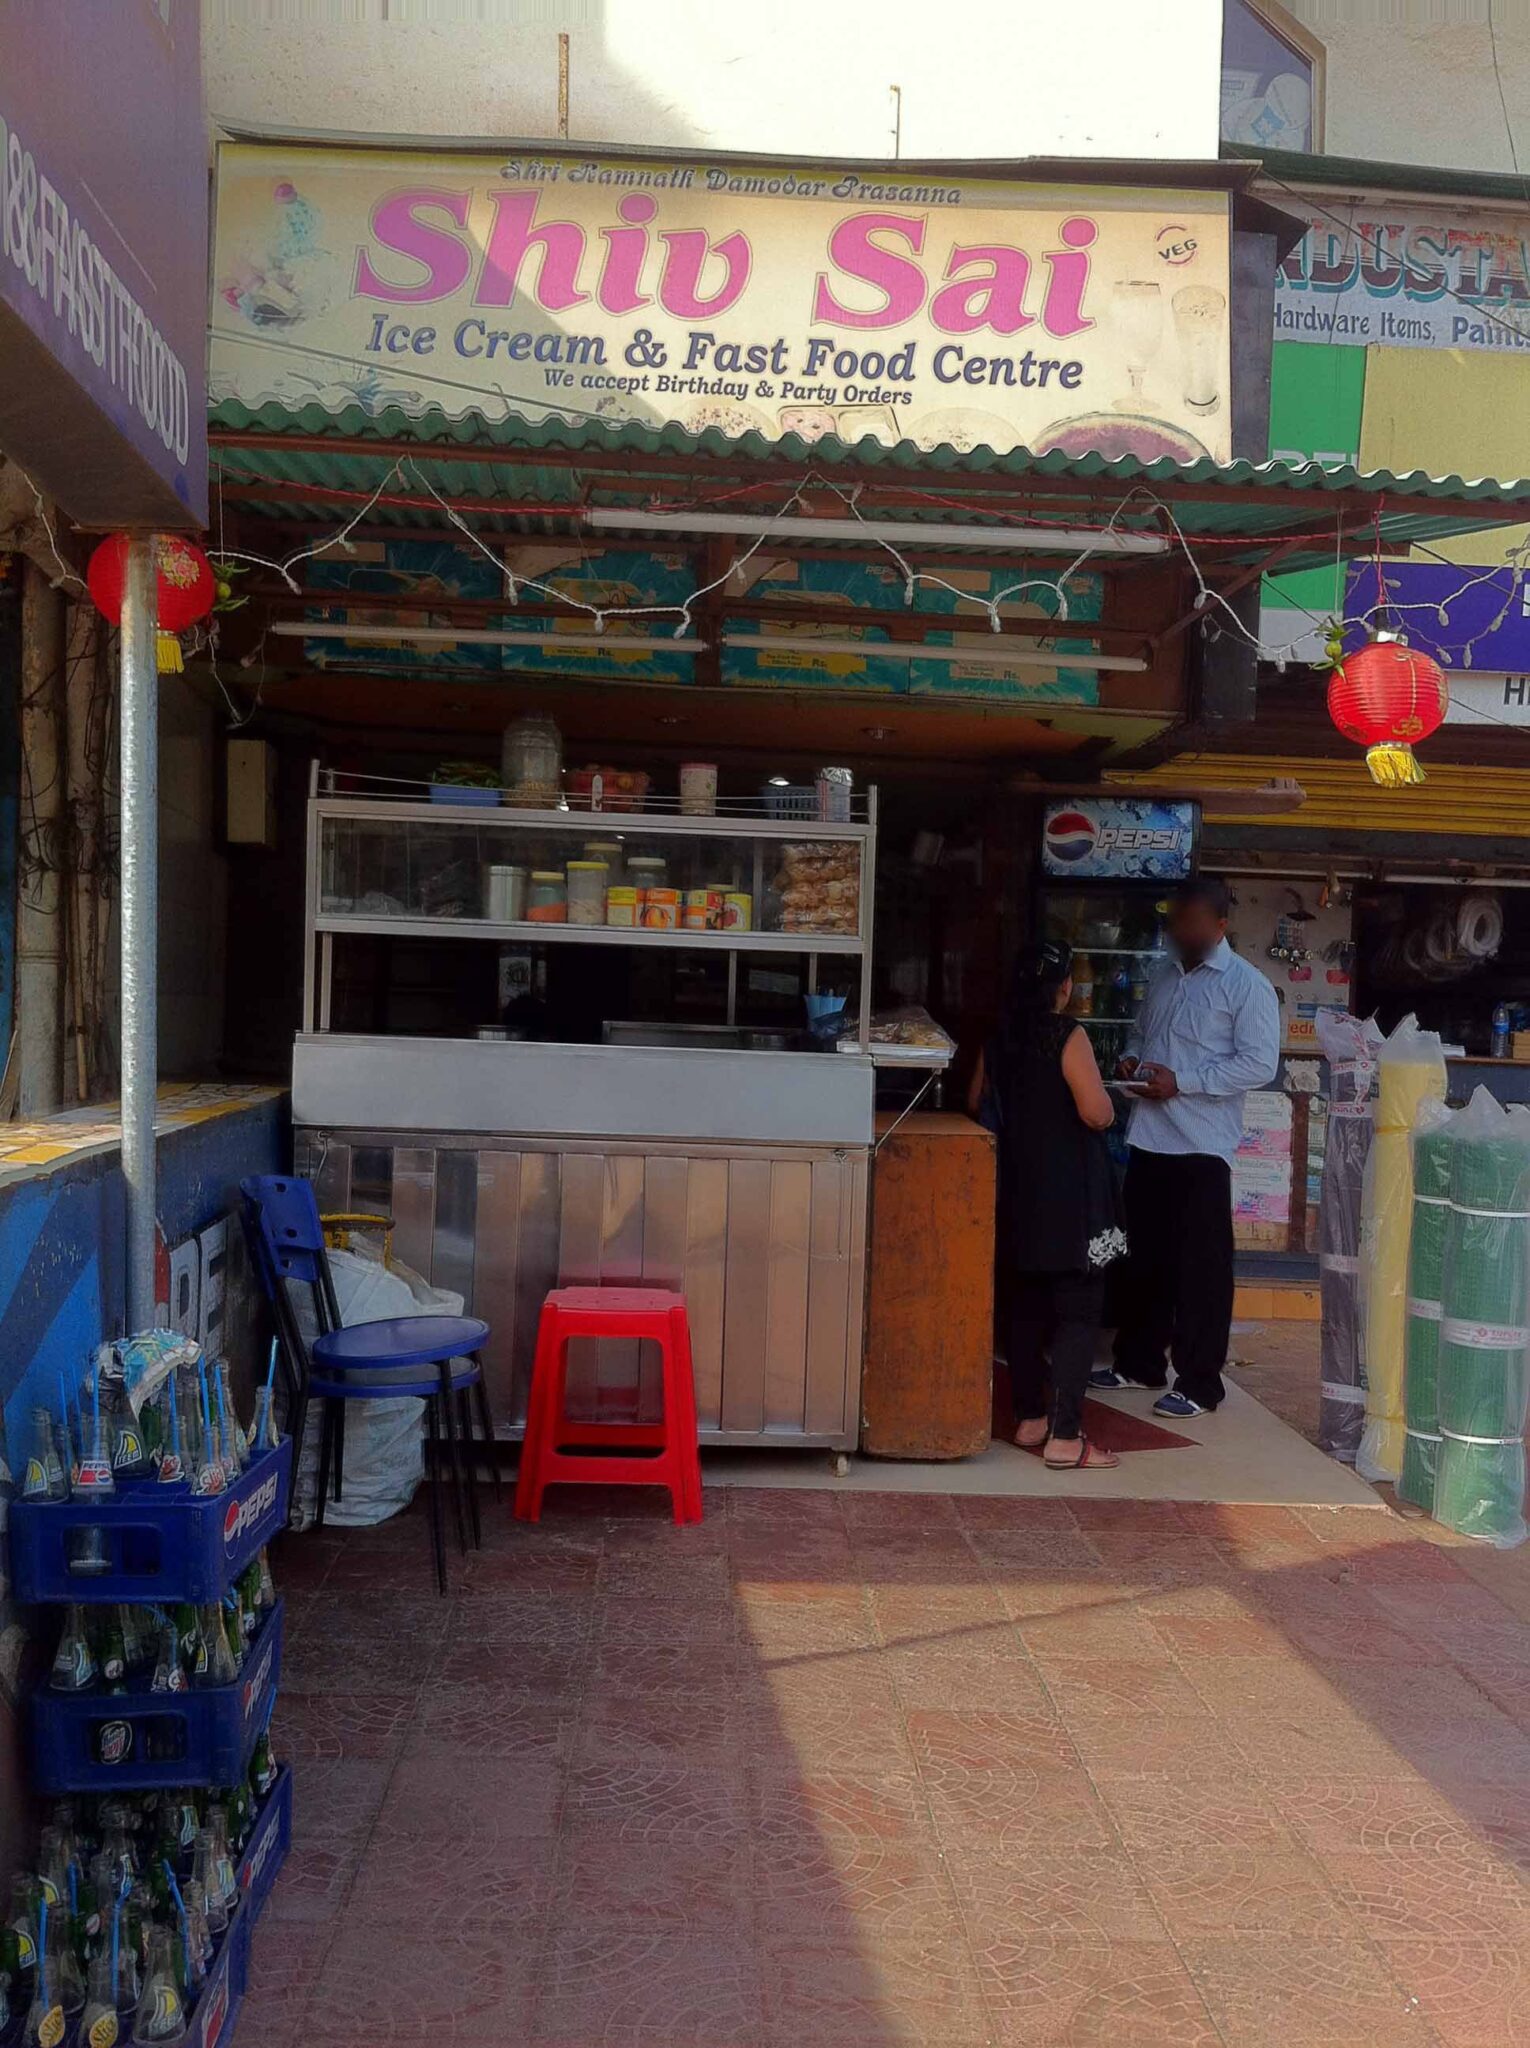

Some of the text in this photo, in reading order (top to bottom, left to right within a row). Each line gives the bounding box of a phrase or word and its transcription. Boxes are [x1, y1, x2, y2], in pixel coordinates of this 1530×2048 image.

[500, 158, 962, 206] Shri Ramnath Damodar Prasanna
[350, 185, 1099, 341] Shiv Sai
[1157, 237, 1199, 262] VEG
[1381, 311, 1436, 345] Items,
[365, 313, 1084, 390] Ice Cream & Fast Food Centre
[545, 368, 912, 407] We accept Birthday & Party Orders
[1096, 828, 1183, 850] PEPSI
[237, 1472, 278, 1538] PEPSI
